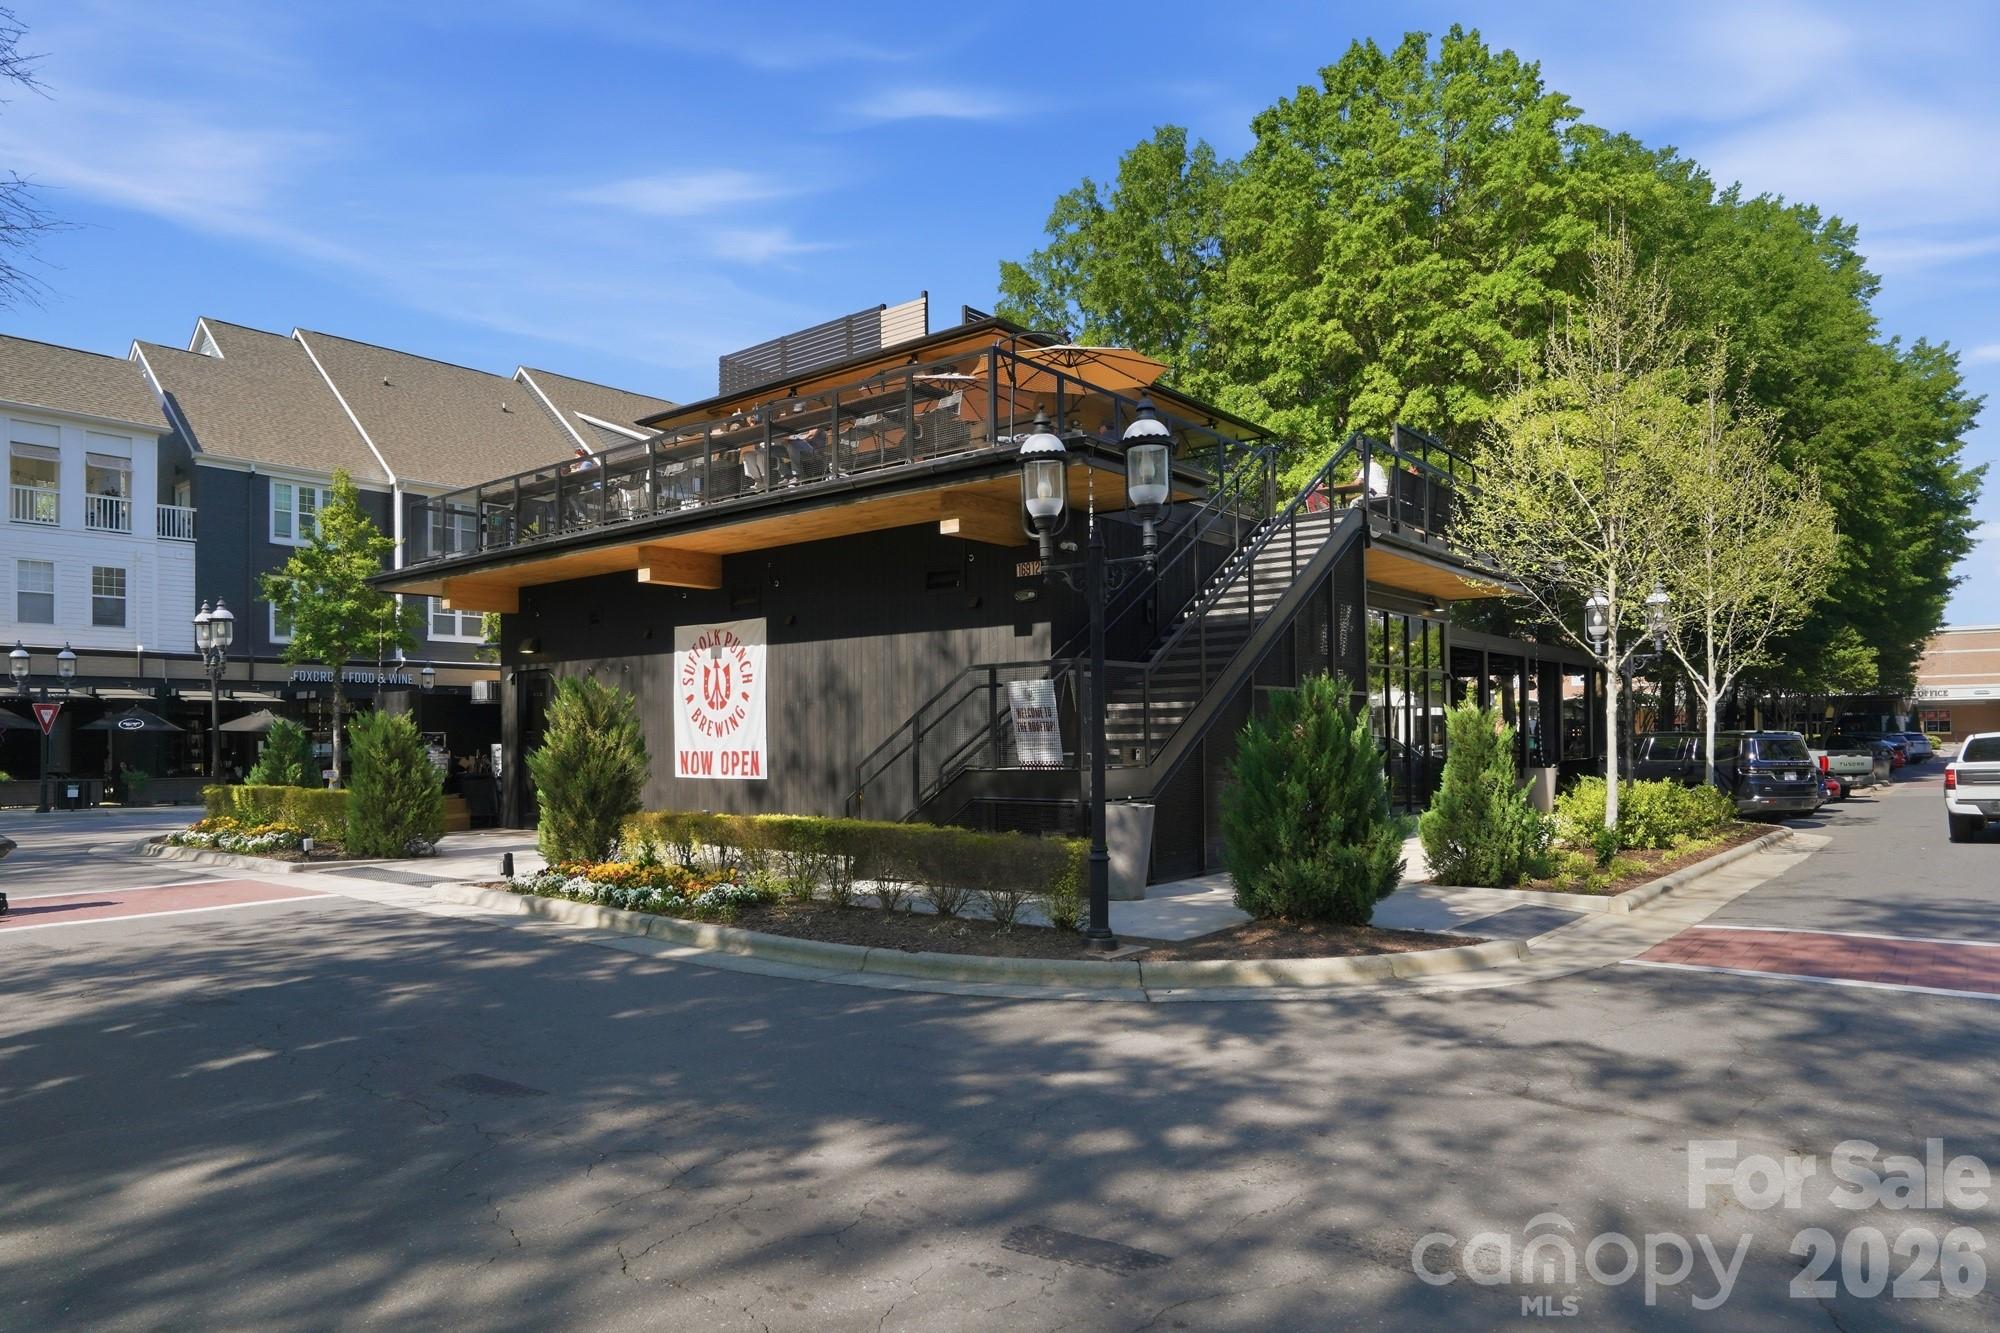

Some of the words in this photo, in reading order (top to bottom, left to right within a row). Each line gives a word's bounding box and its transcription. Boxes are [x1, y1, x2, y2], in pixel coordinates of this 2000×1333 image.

[1016, 561, 1041, 577] 16912
[683, 629, 721, 686] SUFFOLK
[724, 631, 753, 684] PUNCH
[348, 671, 375, 684] FOOD
[378, 673, 387, 684] &
[388, 673, 413, 685] WINE
[1917, 687, 1949, 698] OFFICE
[691, 705, 745, 738] BREWING
[680, 751, 713, 775] NOW
[721, 751, 760, 776] OPEN
